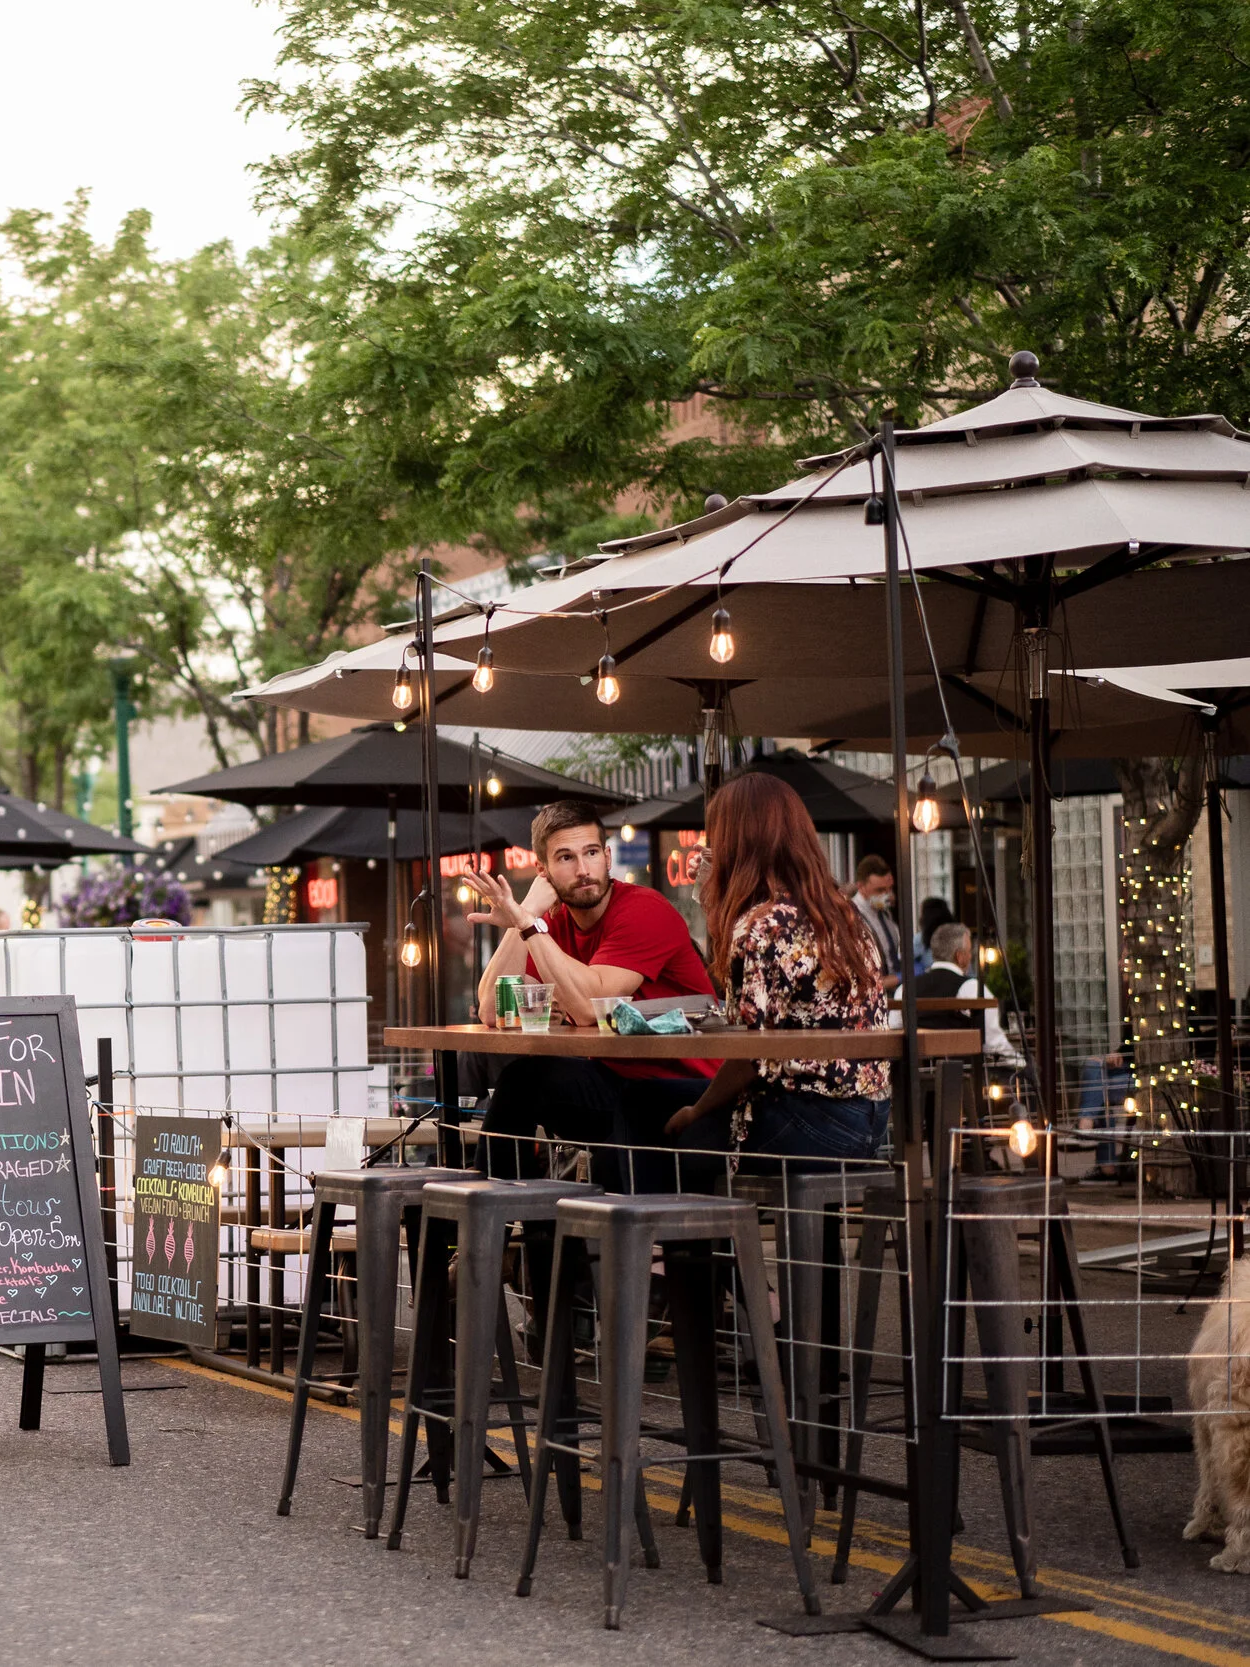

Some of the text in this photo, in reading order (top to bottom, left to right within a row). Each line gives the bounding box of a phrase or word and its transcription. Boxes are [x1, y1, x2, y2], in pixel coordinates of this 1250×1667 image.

[143, 1158, 166, 1176] CRAFT
[140, 1197, 161, 1215] VEGAN
[161, 1198, 179, 1218] FOOD
[135, 1272, 202, 1300] TOGO COCKTAILS
[133, 1291, 172, 1317] AVAILABLE
